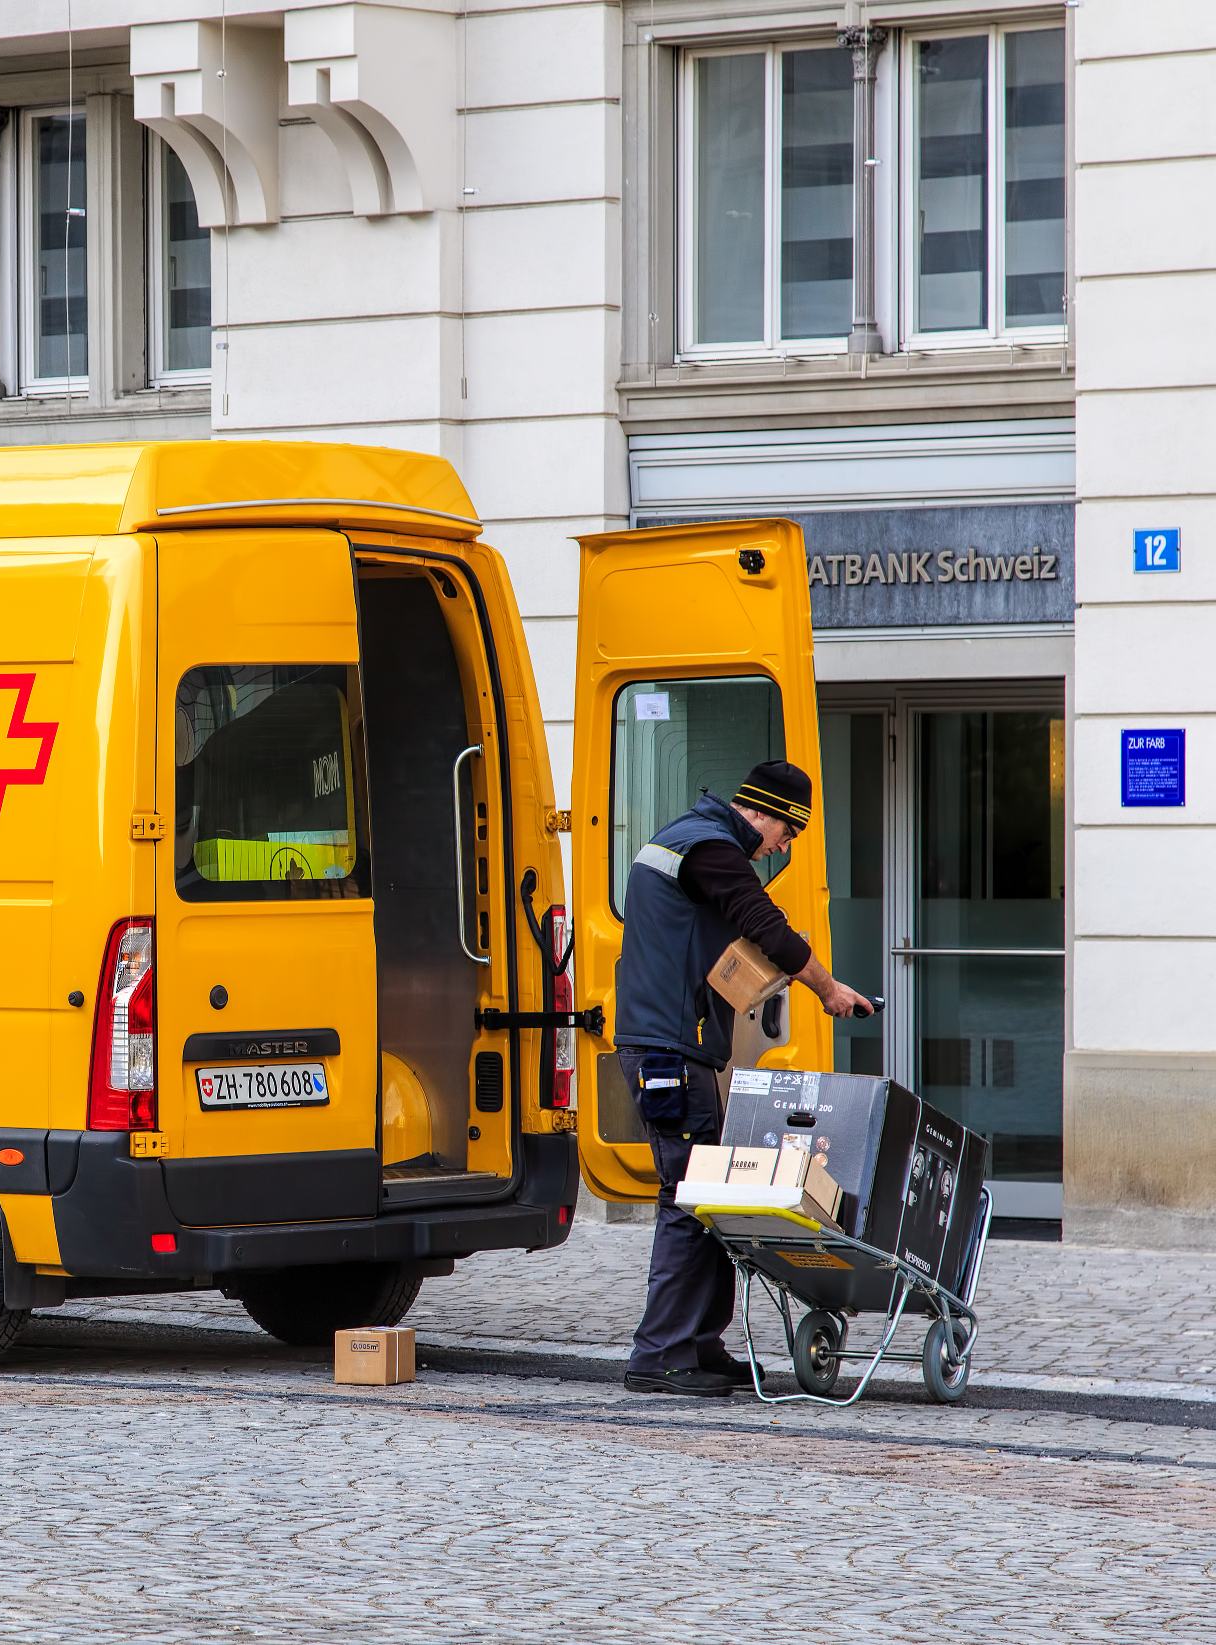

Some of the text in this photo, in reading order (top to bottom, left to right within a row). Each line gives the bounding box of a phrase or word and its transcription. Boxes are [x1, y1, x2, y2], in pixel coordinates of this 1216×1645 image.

[1144, 534, 1167, 566] 12
[806, 546, 1057, 587] ATBANK Schweiz
[1128, 737, 1145, 750] ZUR
[229, 1040, 308, 1056] MASTER
[773, 1099, 833, 1113] GEMINI 200
[925, 1123, 946, 1143] GEMINI
[905, 1247, 931, 1273] NESPRESSO
